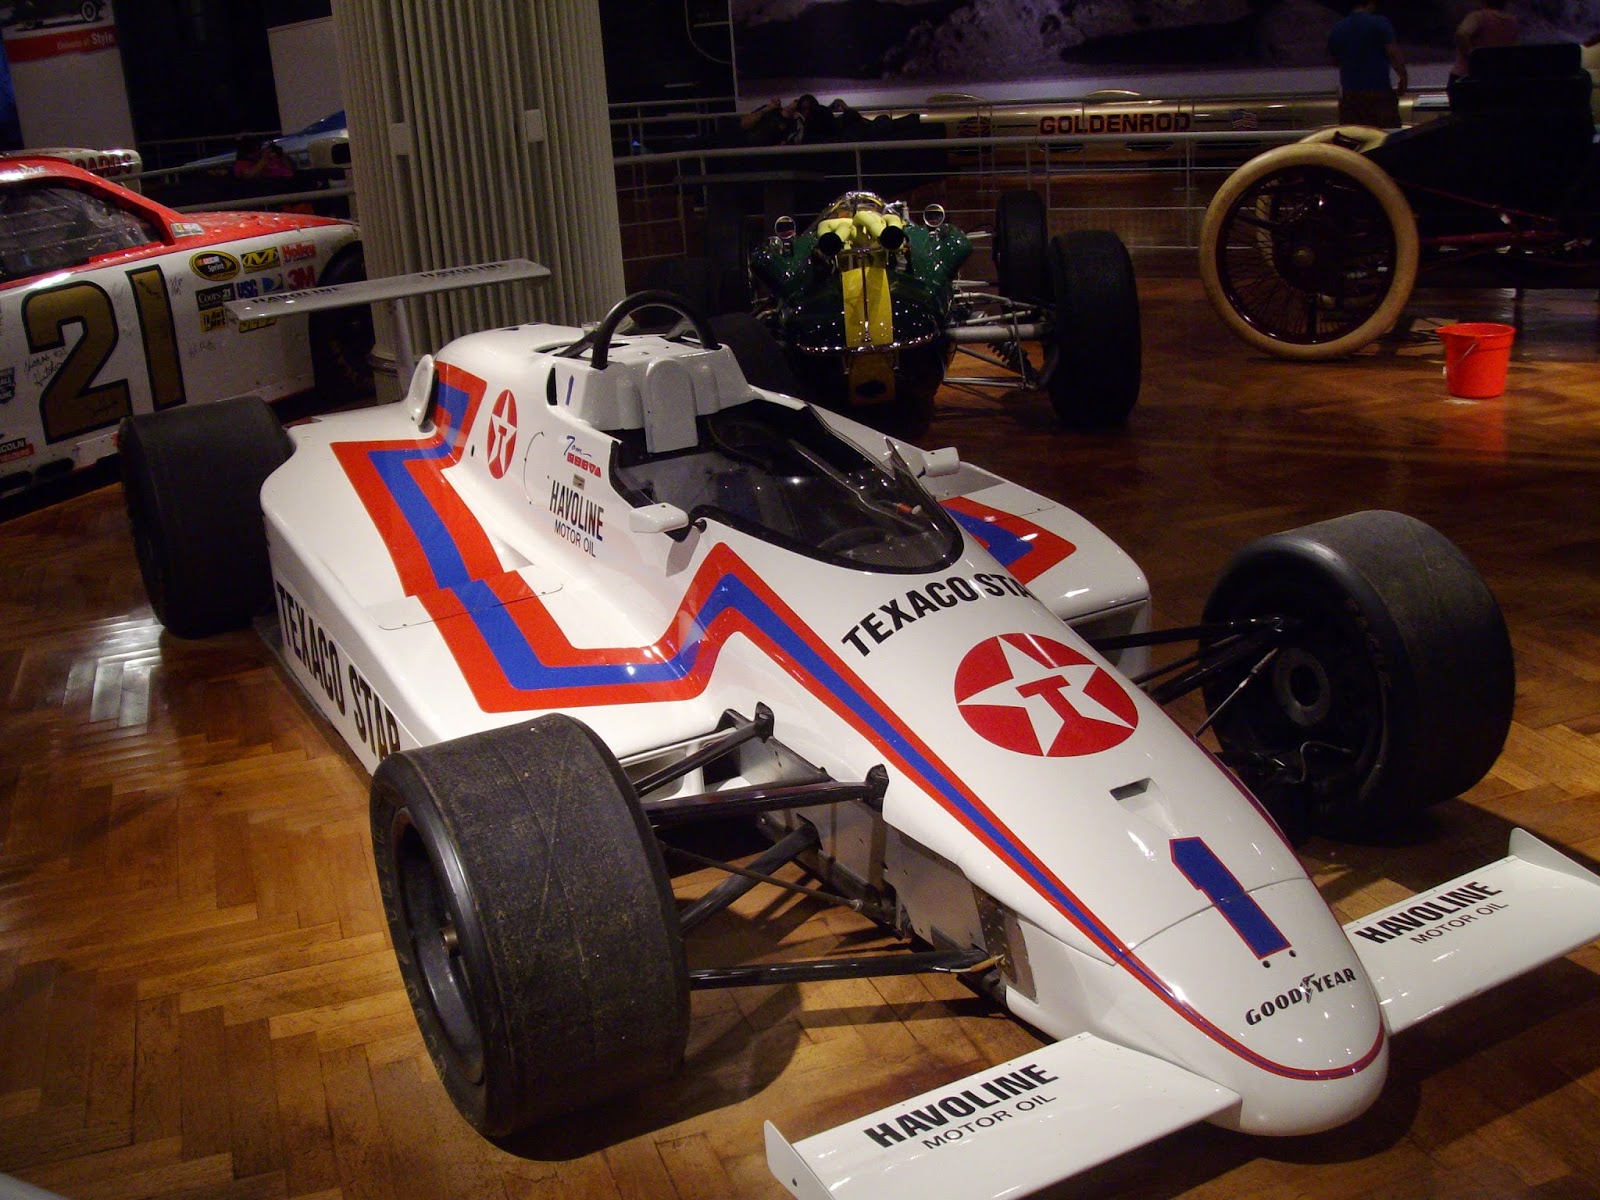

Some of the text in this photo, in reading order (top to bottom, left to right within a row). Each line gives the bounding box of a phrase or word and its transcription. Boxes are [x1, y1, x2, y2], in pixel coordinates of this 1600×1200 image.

[91, 31, 113, 46] Style
[1040, 112, 1192, 135] GOLDENROD
[287, 265, 316, 291] 3M
[21, 264, 187, 445] 21
[563, 435, 592, 457] Tom
[549, 480, 605, 541] HAVOLINE
[554, 519, 597, 558] MOTOR OIL
[841, 575, 980, 657] TEXACO
[276, 580, 346, 716] TEXACO
[1168, 836, 1292, 960] 1
[1353, 880, 1504, 945] HAVOLINE
[1409, 901, 1510, 944] MOTOR OIL
[1245, 966, 1357, 1026] GOODYEAR
[863, 1062, 1060, 1149] HAVOLINE
[921, 1092, 1058, 1151] MOTOR OIL
